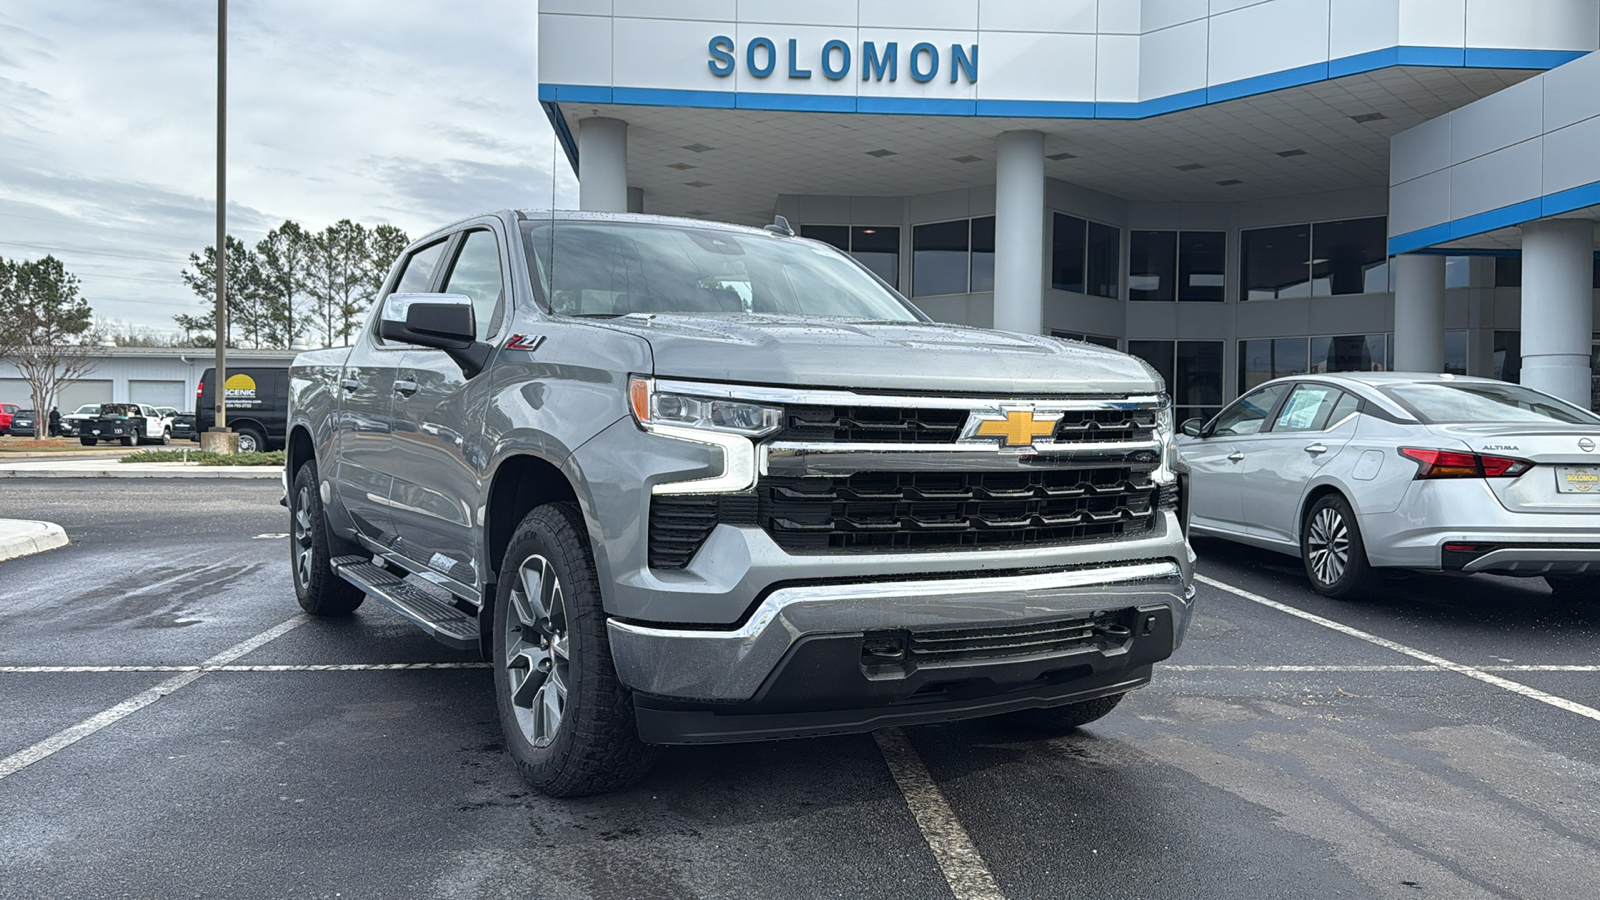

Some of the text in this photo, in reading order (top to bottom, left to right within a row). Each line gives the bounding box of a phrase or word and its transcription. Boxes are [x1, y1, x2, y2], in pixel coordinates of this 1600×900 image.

[708, 35, 979, 84] SOLOMON
[505, 333, 545, 351] Z71
[1566, 473, 1599, 482] SOLOMON
